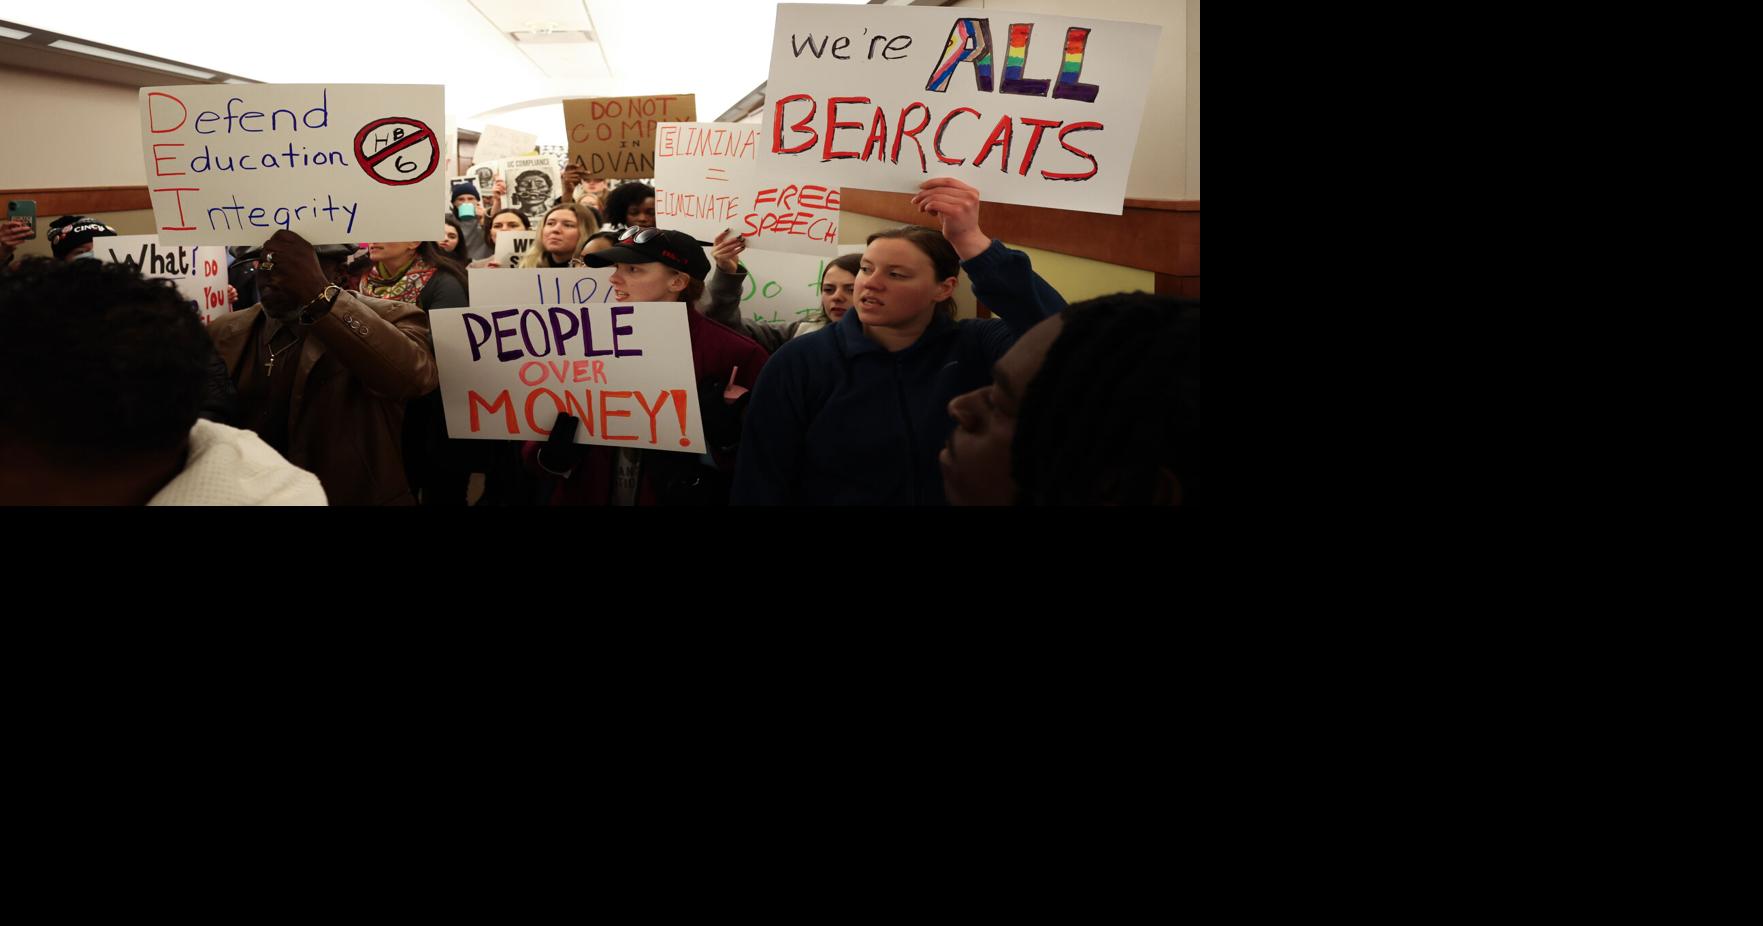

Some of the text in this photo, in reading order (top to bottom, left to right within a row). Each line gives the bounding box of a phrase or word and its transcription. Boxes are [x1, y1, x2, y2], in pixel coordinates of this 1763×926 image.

[925, 17, 1100, 103] ALL
[148, 89, 328, 134] Defend
[591, 97, 677, 120] DO NOT
[572, 116, 690, 143] COMP
[620, 140, 640, 148] IN
[659, 126, 760, 160] ELIMINA
[771, 93, 1104, 182] BEARCATS
[153, 142, 349, 176] Education
[394, 156, 418, 174] 6
[154, 188, 359, 234] Integrity
[656, 184, 840, 223] ELIMINATE FREE
[740, 211, 837, 243] SPEECH
[462, 306, 643, 362] PEOPLE
[518, 360, 608, 387] OVER
[468, 387, 691, 447] MONEY!
